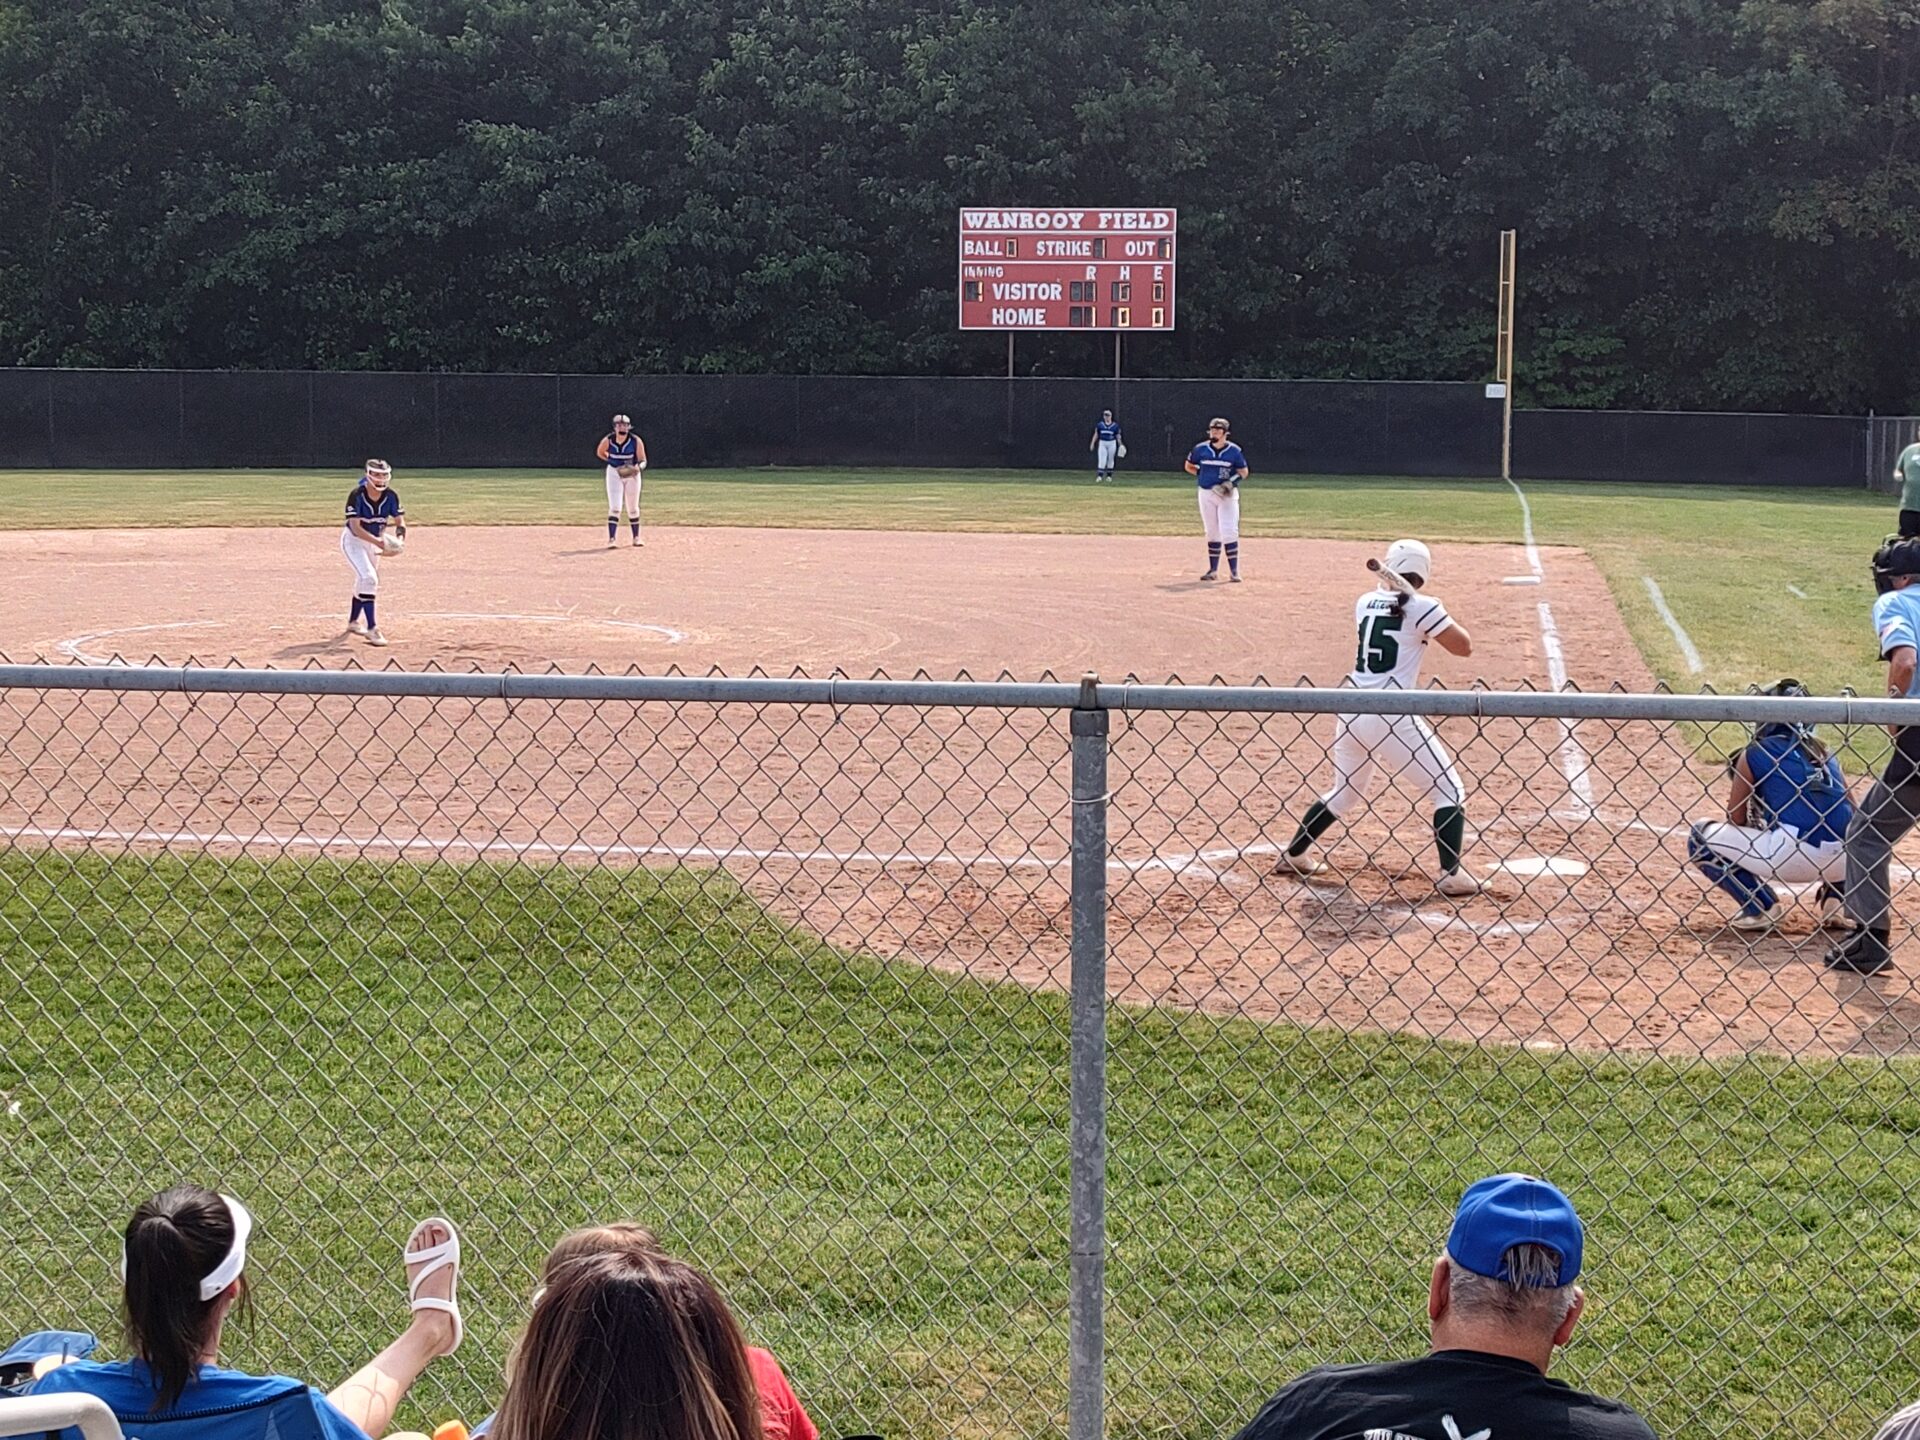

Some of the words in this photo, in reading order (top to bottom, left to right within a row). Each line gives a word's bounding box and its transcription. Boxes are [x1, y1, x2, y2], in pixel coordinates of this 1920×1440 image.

[963, 212, 1084, 229] WANROOY
[1098, 212, 1169, 229] FIELD
[964, 240, 1003, 256] BALL
[1036, 240, 1092, 256] STRIKE
[1125, 240, 1156, 257] OUT
[964, 266, 1004, 278] INNING
[1086, 265, 1097, 281] R
[1120, 265, 1131, 281] H
[1153, 265, 1164, 281] E
[992, 283, 1063, 301] VISITOR
[992, 308, 1047, 326] HOME
[1355, 615, 1404, 674] 15
